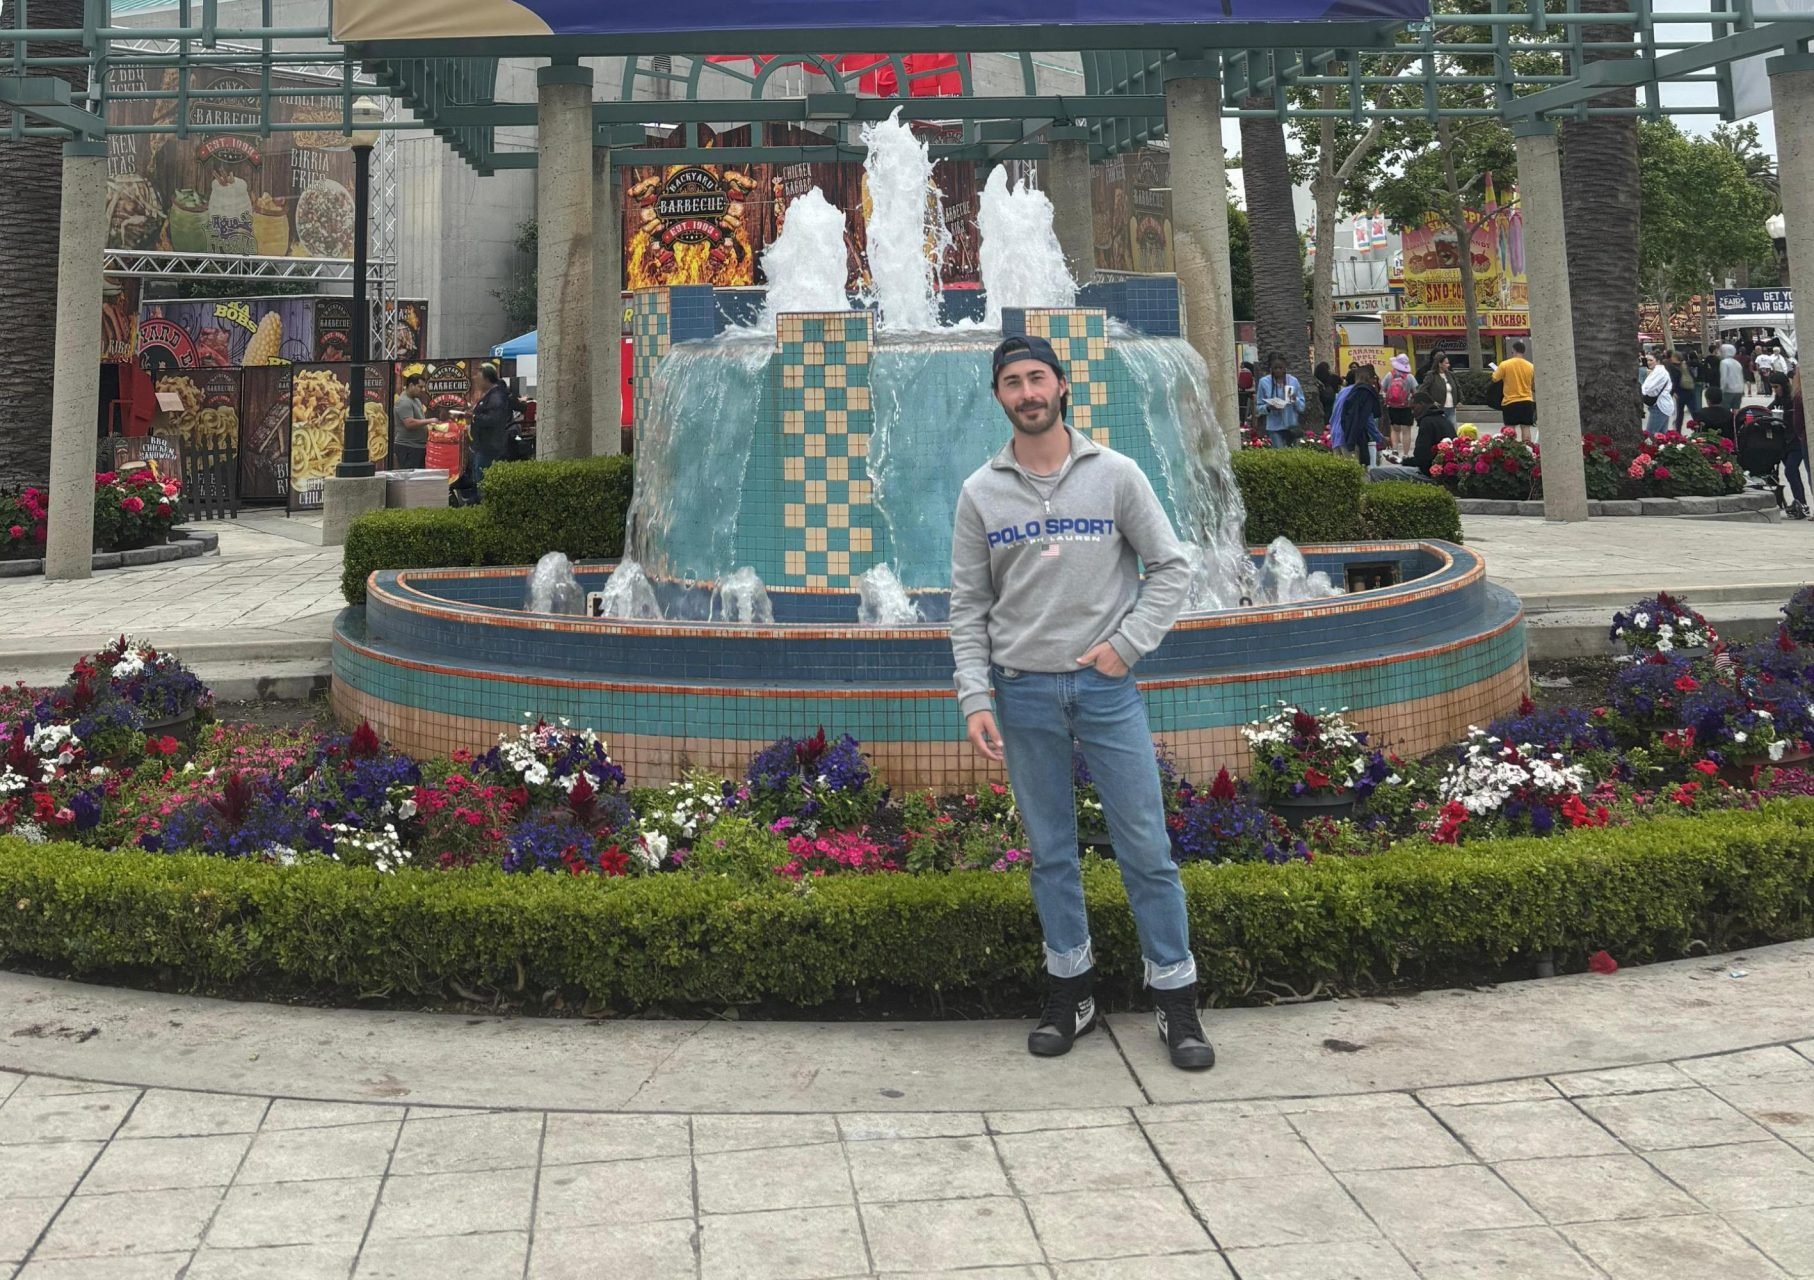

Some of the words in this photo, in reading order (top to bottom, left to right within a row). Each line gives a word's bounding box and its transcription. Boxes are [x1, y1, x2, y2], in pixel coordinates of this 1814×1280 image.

[196, 108, 263, 127] BARBECU
[291, 148, 329, 172] BIRRIA
[783, 162, 812, 180] CHICKEN
[669, 171, 714, 193] BACKYARD
[660, 196, 724, 214] BARBECUE
[1724, 297, 1741, 305] FAIR
[1763, 291, 1780, 301] GET
[1752, 302, 1771, 312] FAIR
[213, 303, 258, 334] BOBS
[1417, 315, 1450, 327] COTTON
[1492, 315, 1528, 327] NACHOS
[429, 381, 468, 391] BARBECUE
[987, 521, 1041, 549] POLO
[1045, 518, 1114, 535] SPORT
